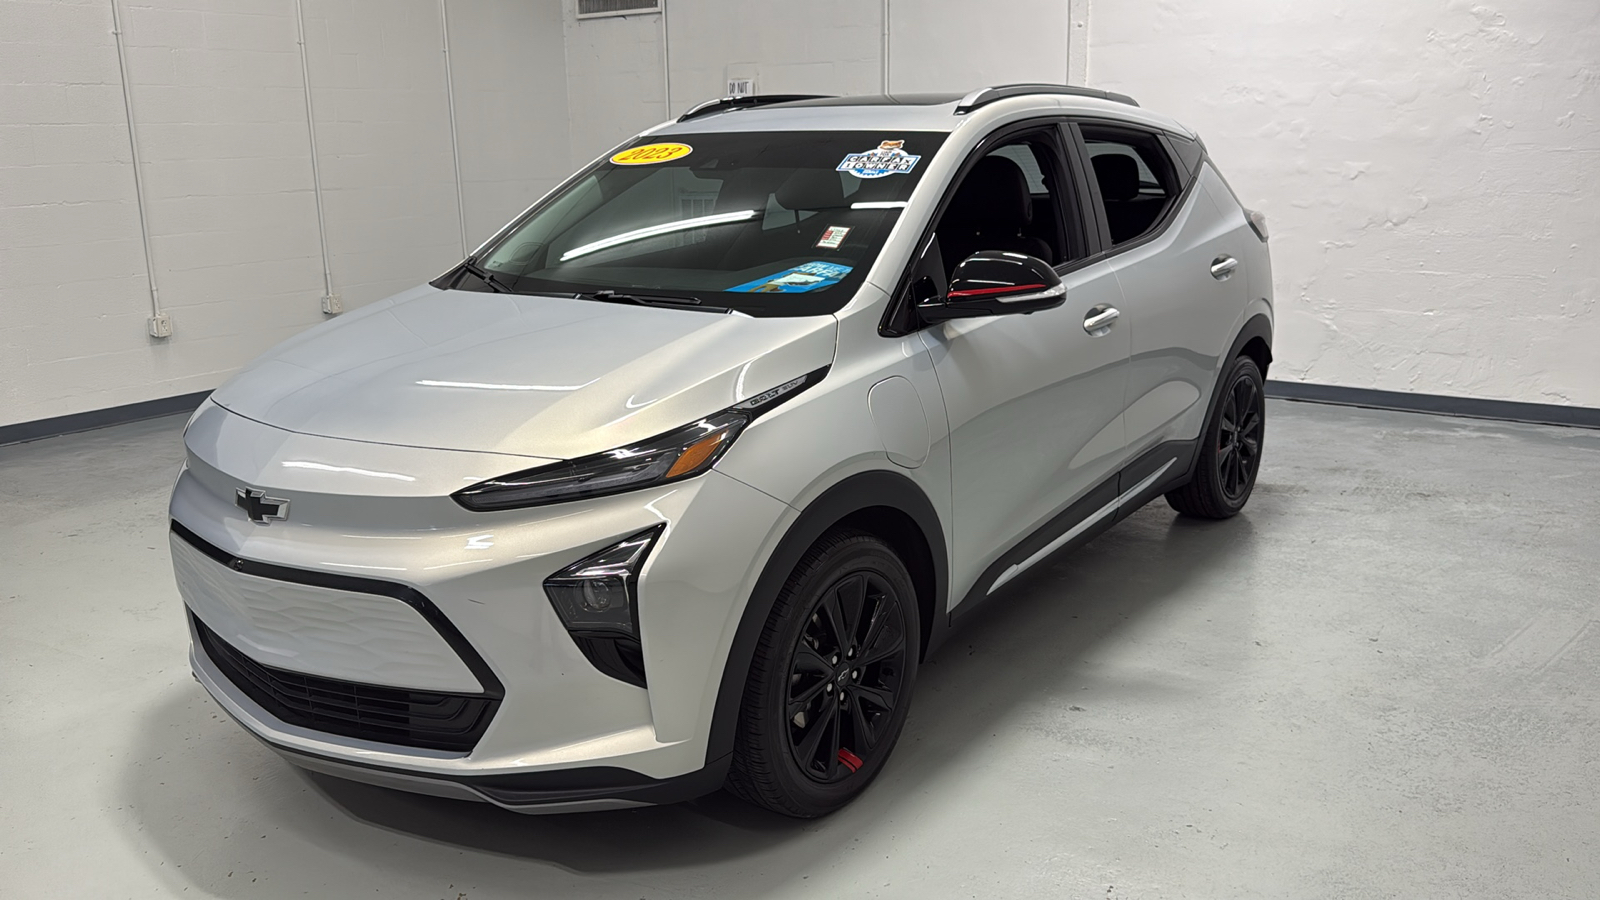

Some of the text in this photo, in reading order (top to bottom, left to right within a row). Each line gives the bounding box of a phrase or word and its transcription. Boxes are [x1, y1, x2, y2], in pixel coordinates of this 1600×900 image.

[729, 81, 749, 95] DO NOT
[618, 147, 683, 161] 2023
[847, 156, 912, 165] CARFAX
[750, 389, 780, 406] BOLT
